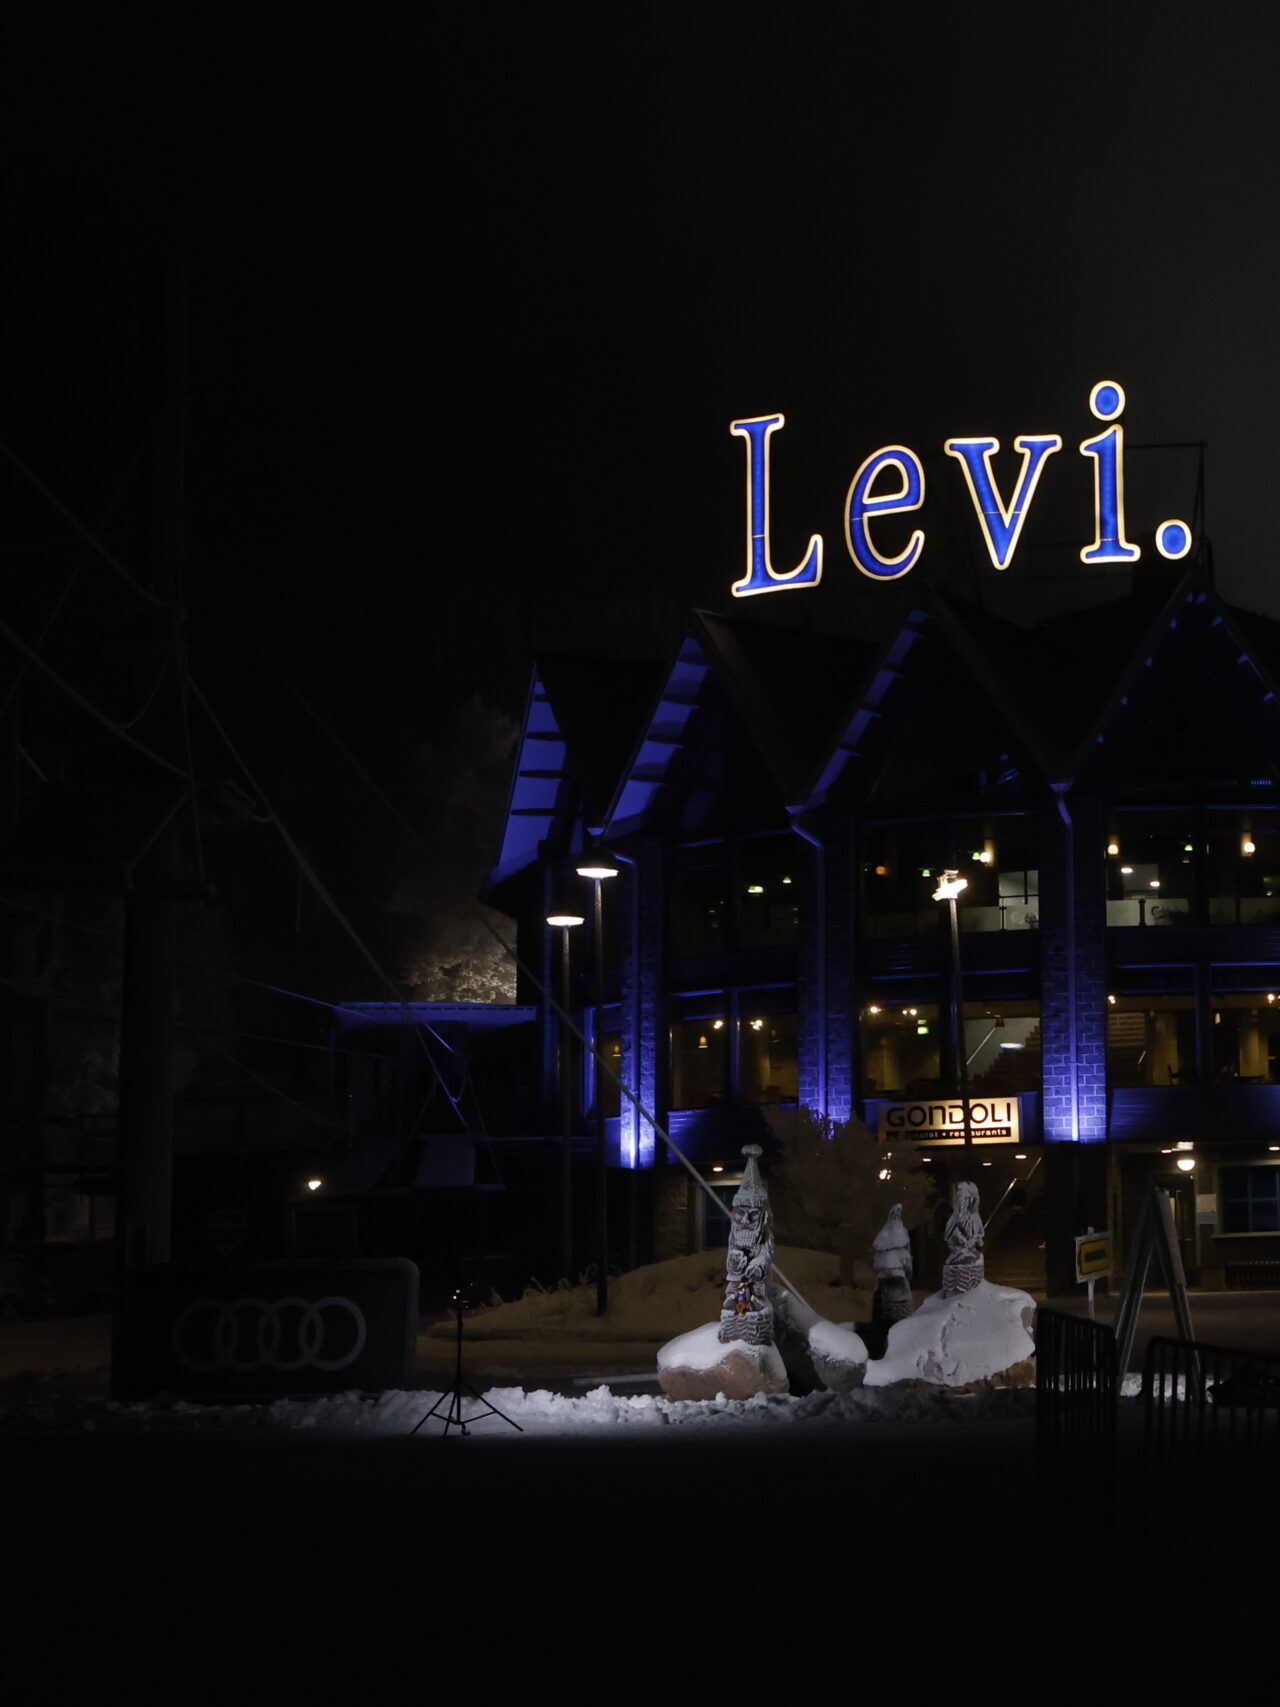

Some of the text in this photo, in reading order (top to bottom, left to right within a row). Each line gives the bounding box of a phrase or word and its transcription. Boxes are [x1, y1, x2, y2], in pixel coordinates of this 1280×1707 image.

[730, 380, 1192, 597] Levi.
[886, 1103, 1011, 1128] GONDOLI
[949, 1129, 1007, 1138] resaurants
